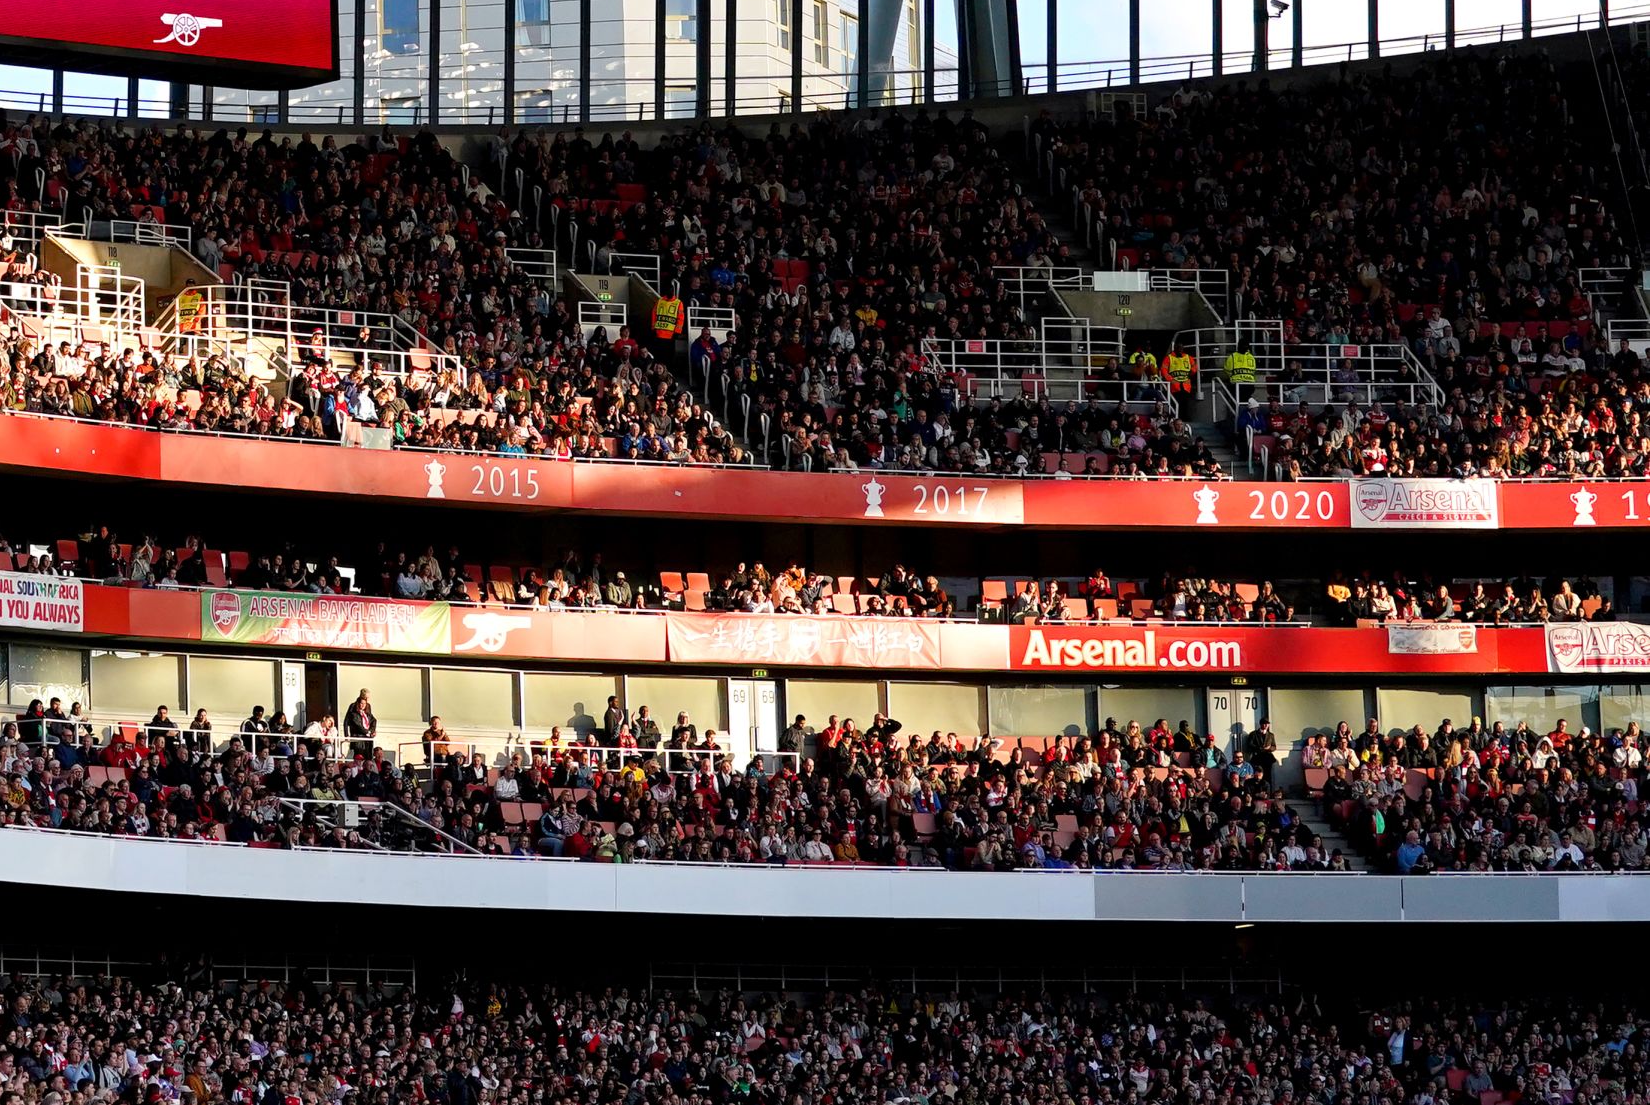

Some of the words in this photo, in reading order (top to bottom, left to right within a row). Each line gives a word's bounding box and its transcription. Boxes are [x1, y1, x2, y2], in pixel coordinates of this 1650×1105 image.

[598, 279, 609, 290] 119
[1118, 295, 1130, 305] 120
[471, 464, 539, 500] 2015
[913, 484, 989, 517] 2017
[1249, 490, 1334, 520] 2020
[1388, 482, 1491, 511] Arsenal
[1621, 490, 1650, 521] 1
[17, 580, 47, 598] SOUTH
[47, 583, 79, 600] AFRICA
[7, 599, 29, 620] YOU
[32, 601, 81, 625] ALWAYS
[249, 596, 318, 621] ARSENAL
[318, 599, 416, 625] BANGLADESH
[1022, 629, 1242, 668] Arsenal.com
[733, 689, 746, 703] 69
[762, 690, 775, 704] 69
[1213, 697, 1228, 710] 70
[1244, 697, 1258, 710] 70
